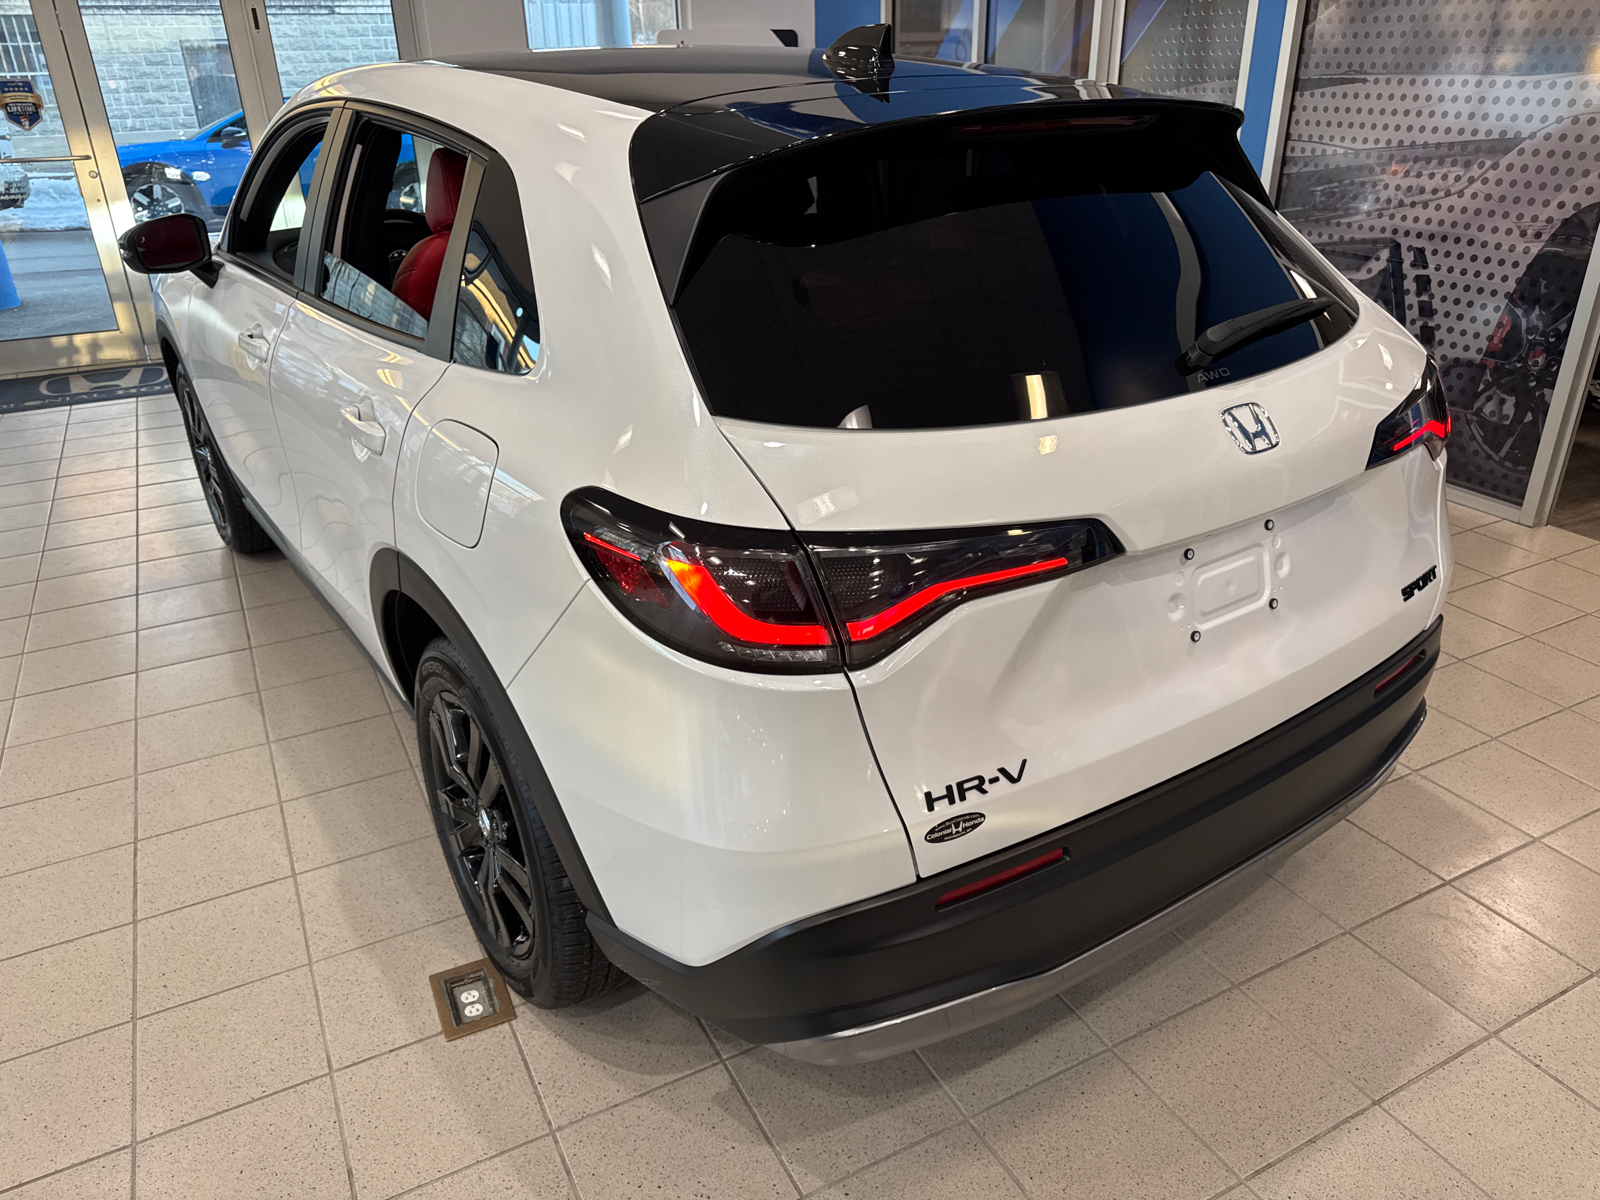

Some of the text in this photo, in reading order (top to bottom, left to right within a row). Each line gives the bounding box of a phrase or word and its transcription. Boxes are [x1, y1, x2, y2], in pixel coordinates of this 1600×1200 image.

[1197, 367, 1231, 384] AWD
[1400, 564, 1437, 602] SPORT
[924, 758, 1027, 812] HR-V
[926, 816, 985, 841] Colonial Honda
